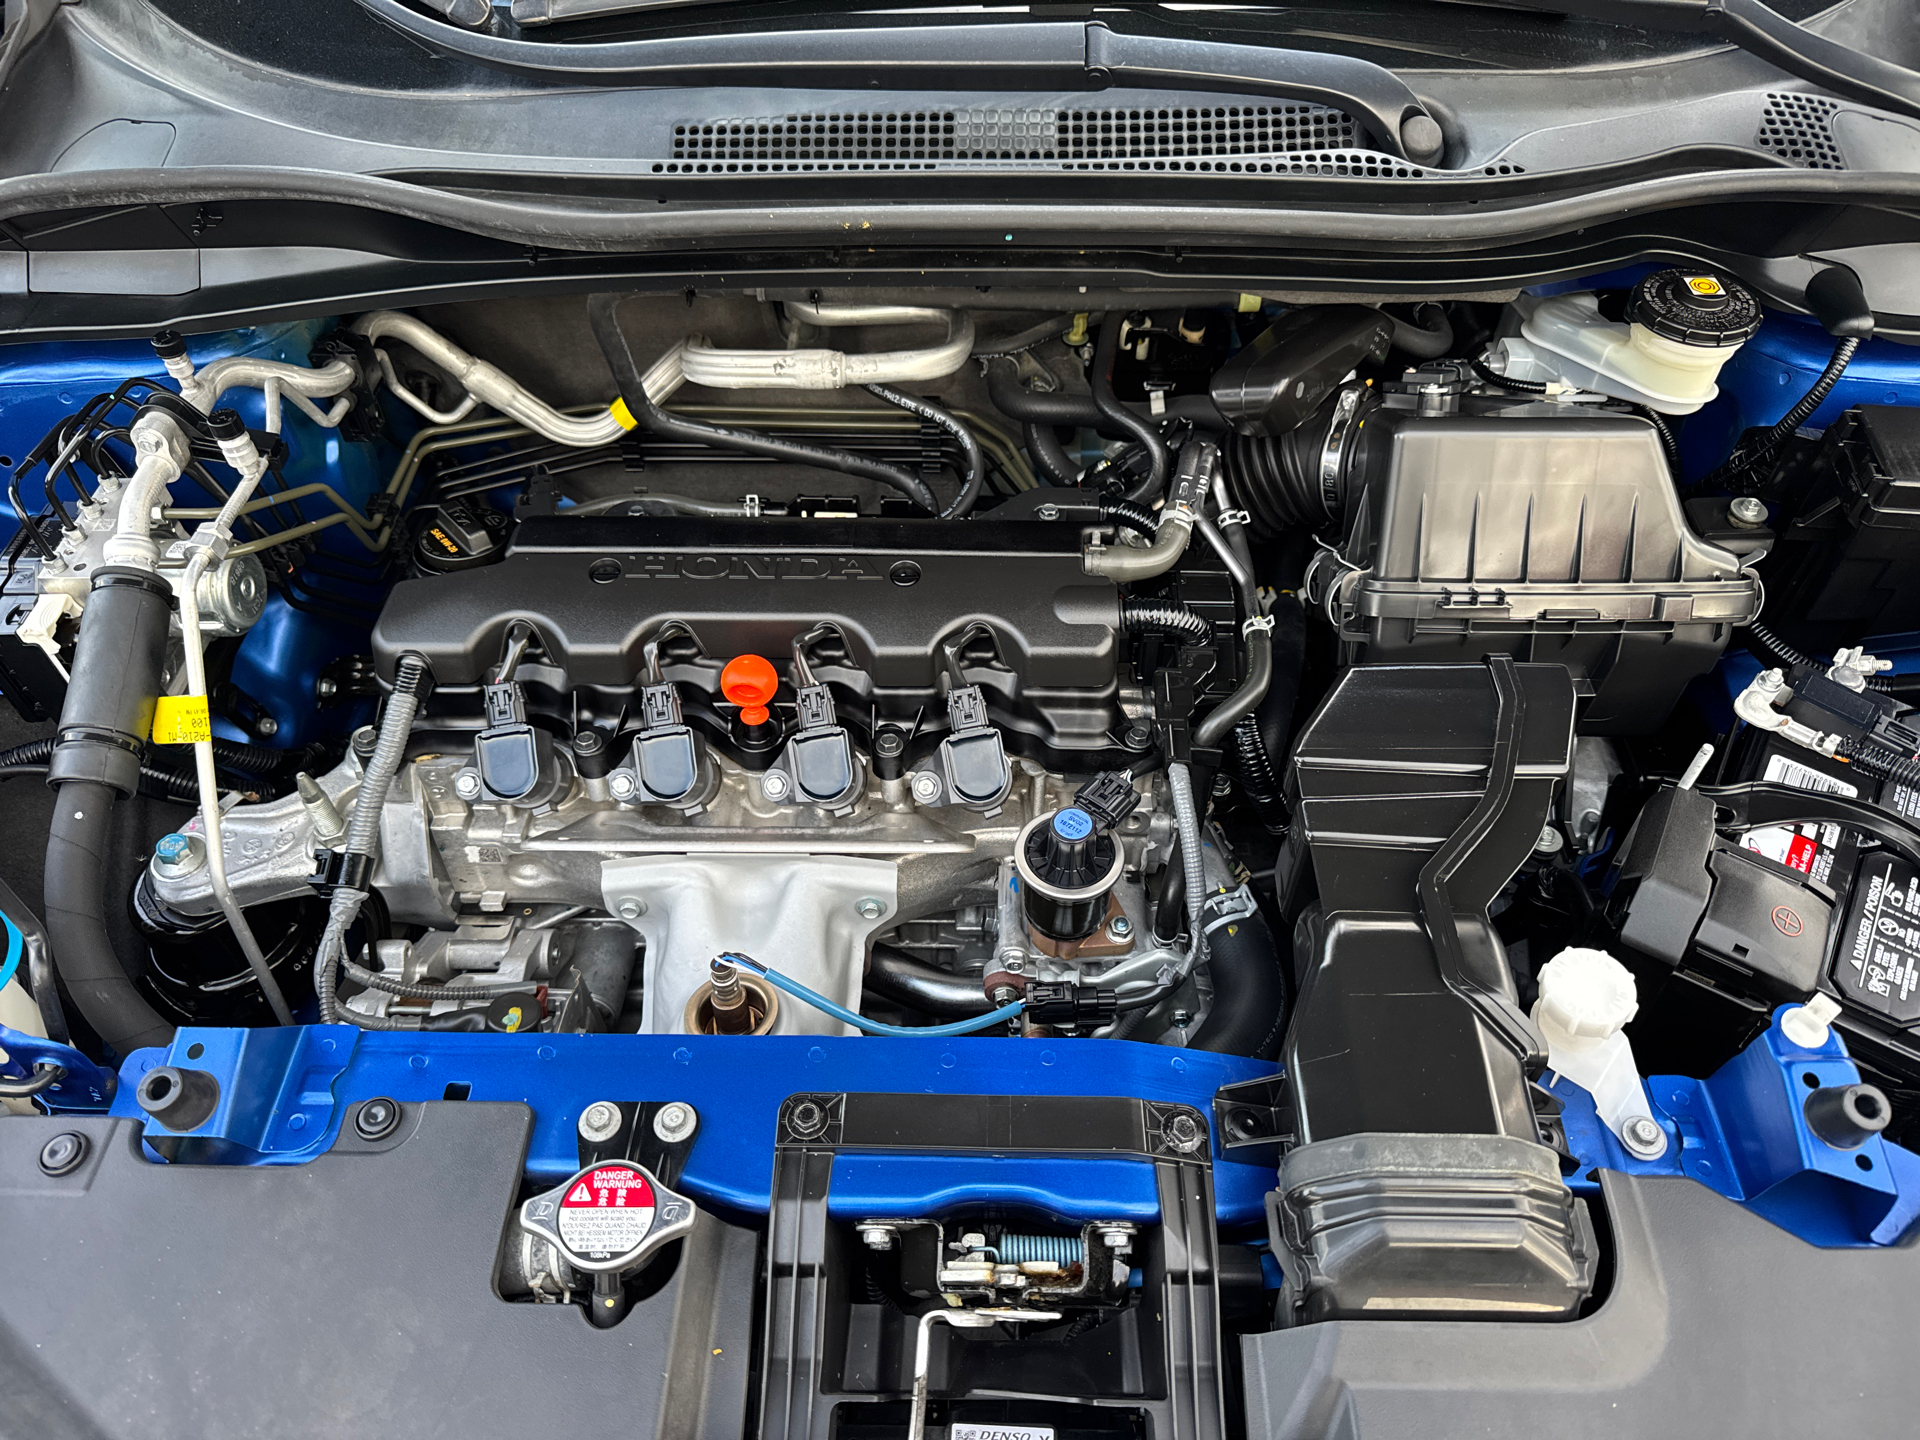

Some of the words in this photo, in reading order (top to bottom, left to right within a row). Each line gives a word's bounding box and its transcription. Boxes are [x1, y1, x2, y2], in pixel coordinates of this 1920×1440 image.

[430, 528, 445, 540] SAE
[440, 538, 458, 553] 0W-20
[625, 555, 883, 580] HONDA
[593, 1179, 642, 1188] WARNUNG
[594, 1171, 634, 1180] DANGER
